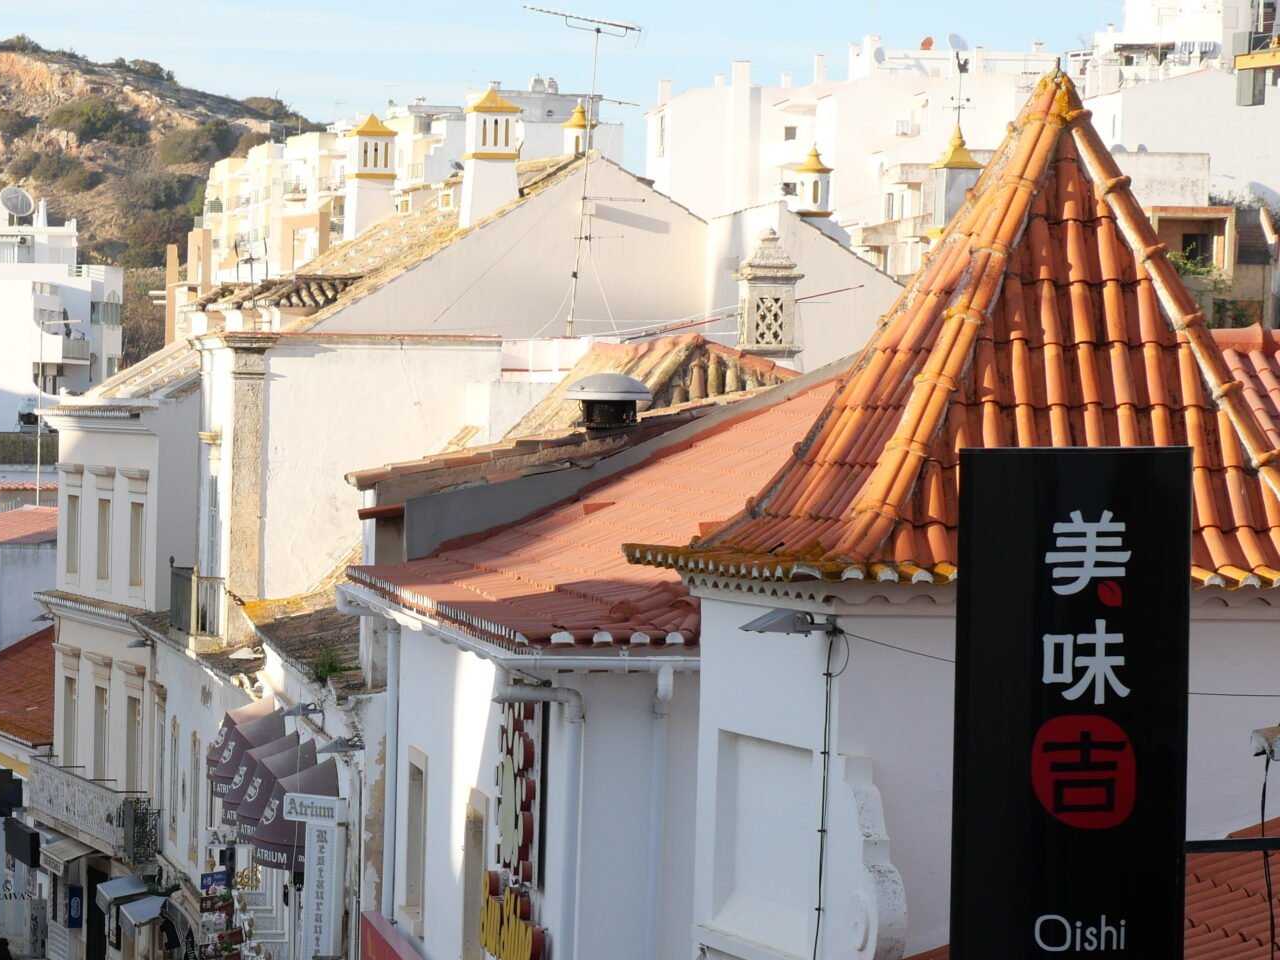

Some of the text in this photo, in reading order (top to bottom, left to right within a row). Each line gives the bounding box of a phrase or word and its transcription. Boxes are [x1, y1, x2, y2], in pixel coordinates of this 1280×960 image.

[287, 798, 334, 818] Atrium
[256, 848, 287, 864] ATRIUM
[1034, 914, 1126, 951] Oishi
